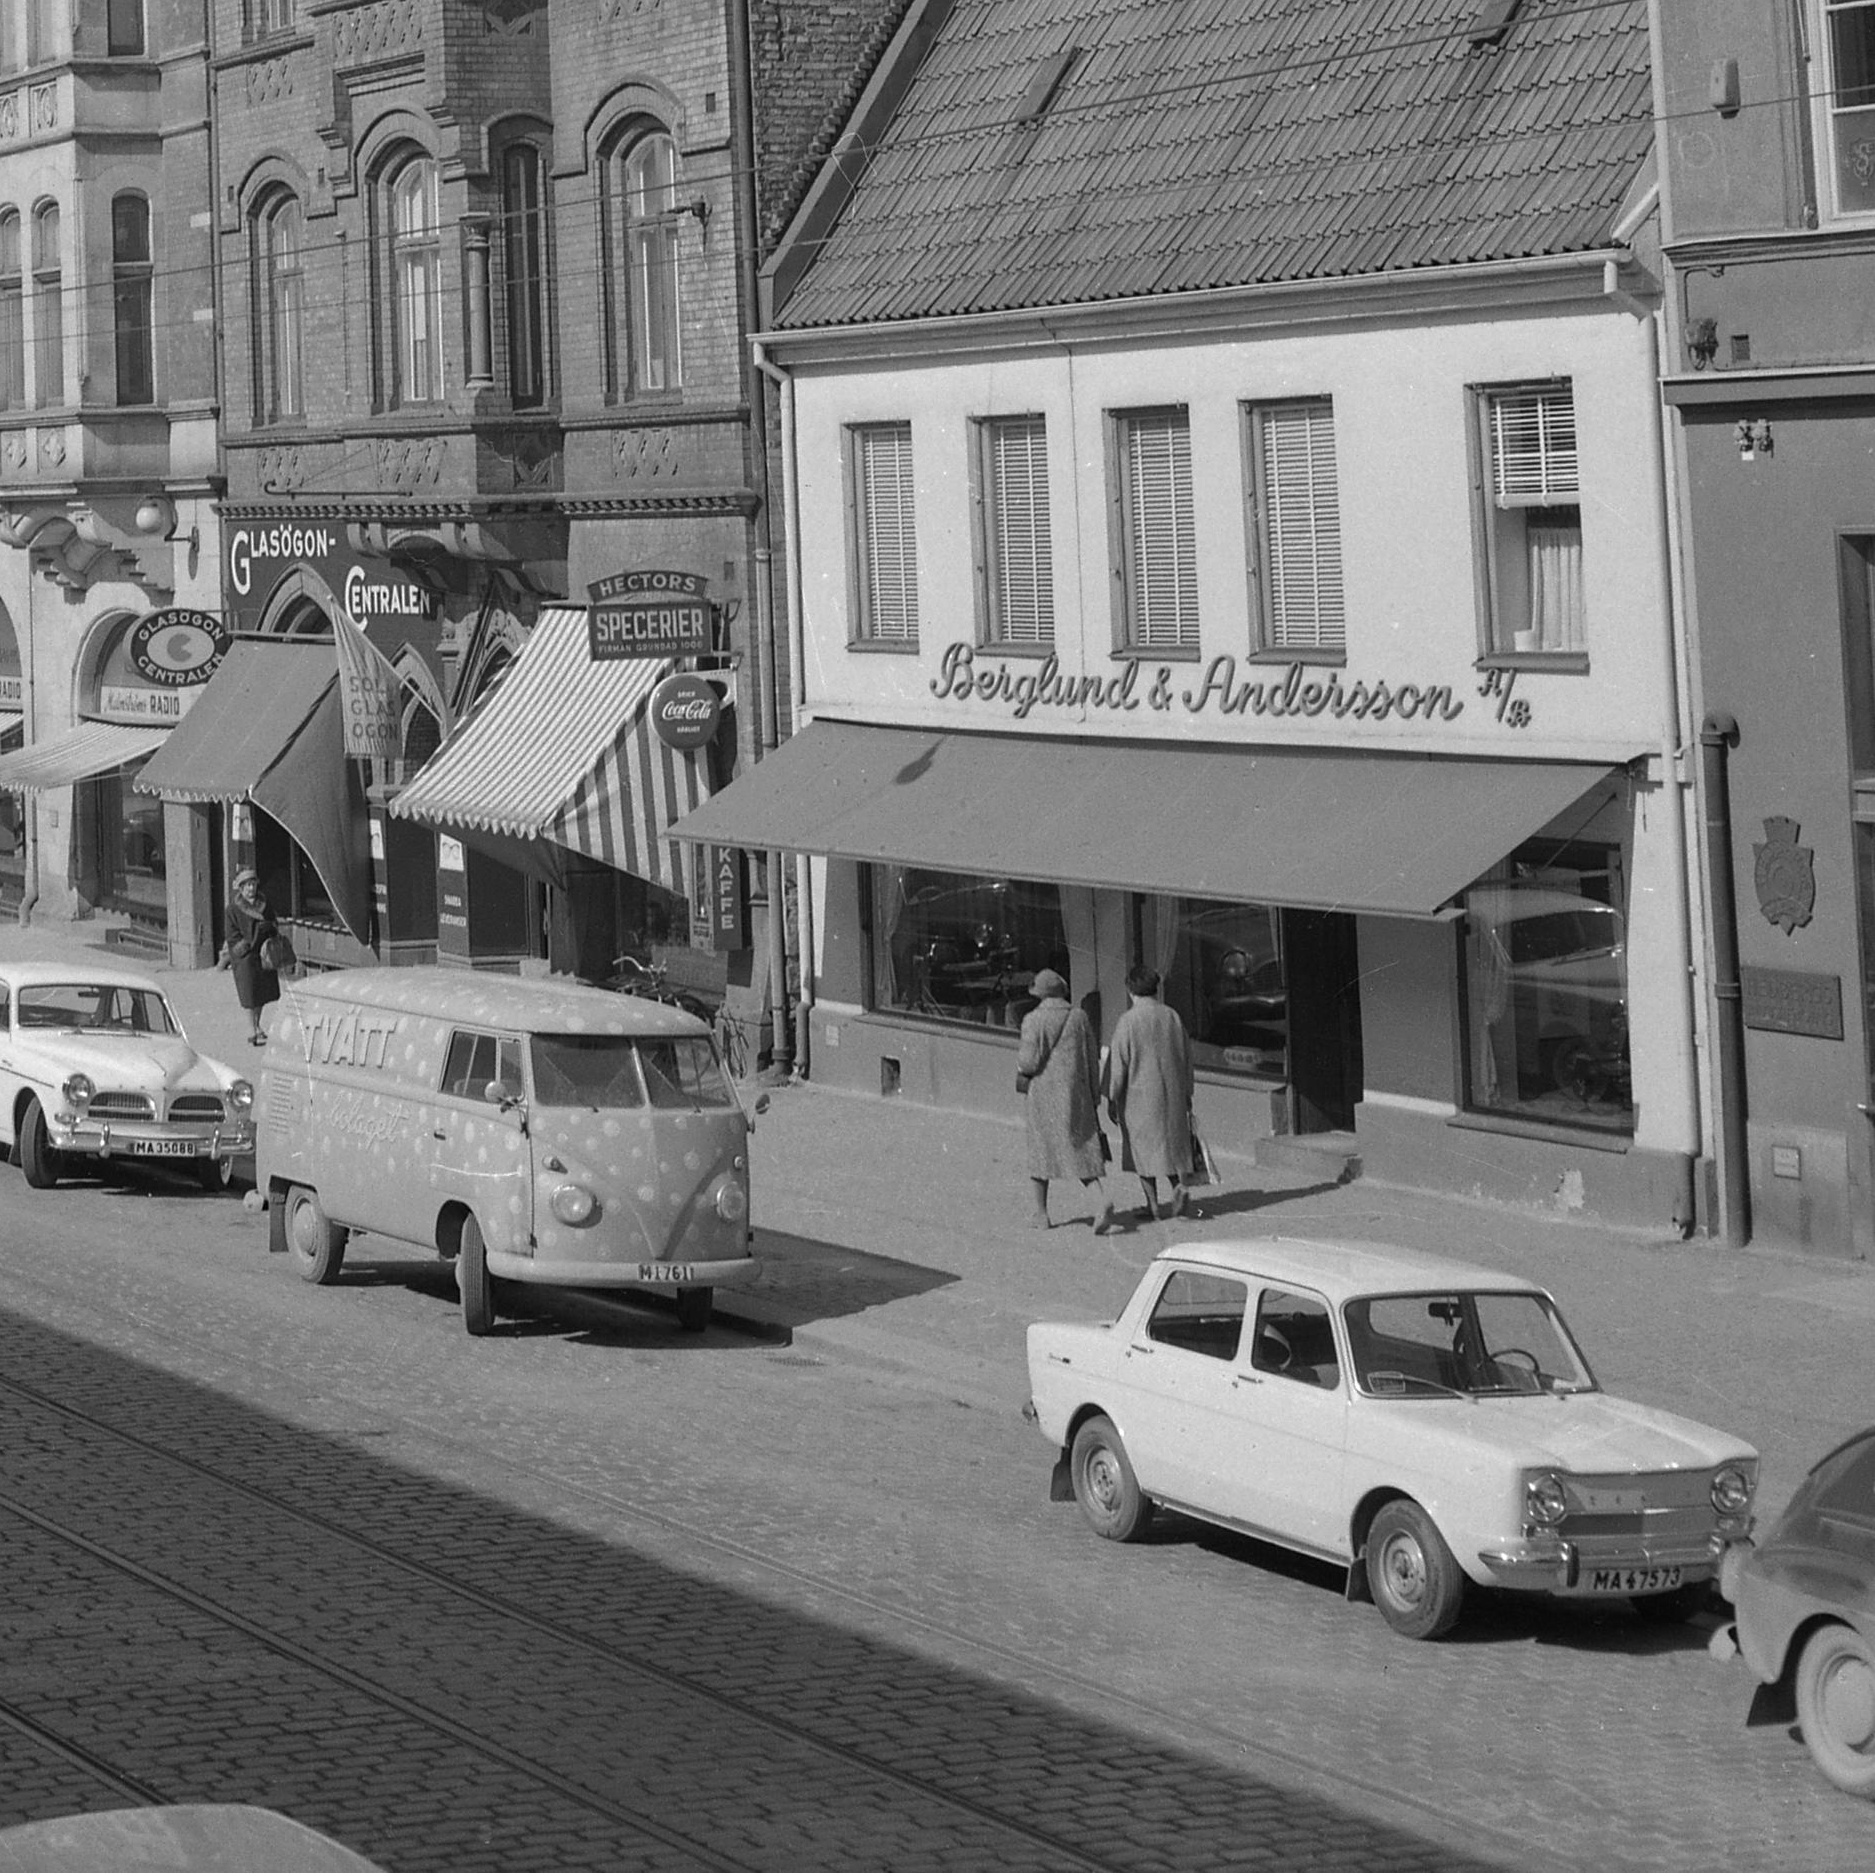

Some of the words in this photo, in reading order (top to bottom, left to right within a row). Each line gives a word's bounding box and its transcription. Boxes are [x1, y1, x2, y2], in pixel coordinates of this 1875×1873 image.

[231, 523, 336, 596] GLASÖGON-
[345, 565, 431, 632] CENTRALEN
[598, 573, 696, 597] HECTORS
[138, 611, 224, 641] GLASÖGON
[596, 608, 704, 641] SPECERIER
[138, 653, 223, 684] CENTRALEN
[929, 642, 1140, 719] Berglund
[1148, 666, 1174, 712] &
[1182, 655, 1464, 721] Andersson
[150, 694, 181, 715] RADIO
[351, 699, 396, 717] GLAS
[718, 847, 735, 930] KAFFE
[305, 1004, 398, 1070] TVÄTT
